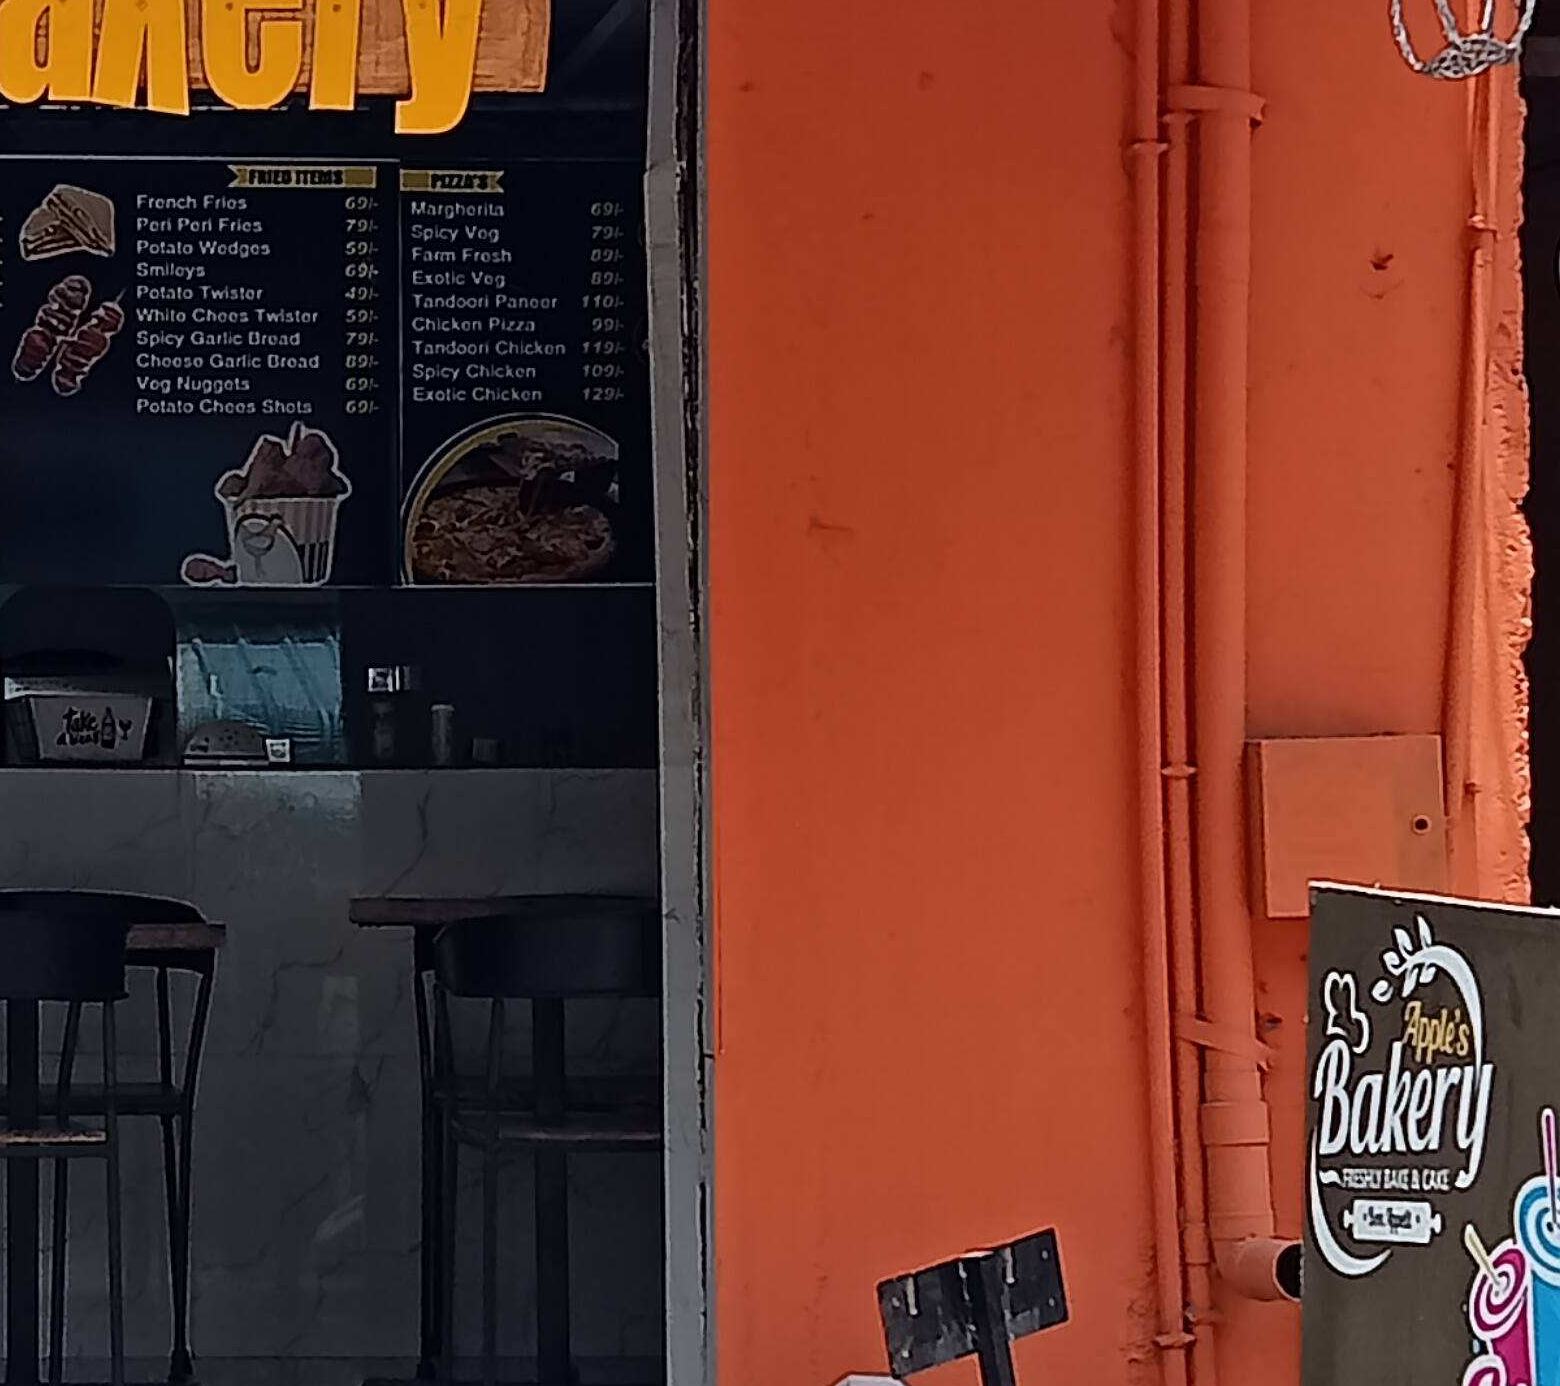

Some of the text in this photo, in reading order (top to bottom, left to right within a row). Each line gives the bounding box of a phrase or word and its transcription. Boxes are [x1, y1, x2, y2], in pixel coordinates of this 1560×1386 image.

[248, 170, 344, 185] FRIED ITEMS
[137, 195, 197, 209] French
[203, 195, 247, 209] Fries
[411, 201, 504, 219] Margherita
[137, 218, 171, 232] Peri
[177, 218, 212, 232] Peri
[219, 218, 263, 232] Fries
[411, 225, 459, 242] Spicy
[465, 225, 500, 243] Veg
[137, 240, 193, 255] Potato
[198, 241, 271, 258] Wedges
[411, 248, 455, 262] Farm
[462, 248, 512, 262] Fresh
[136, 263, 205, 280] Smileys
[412, 271, 465, 285] Exotic
[471, 271, 506, 288] Veg
[137, 286, 193, 300] Potato
[199, 286, 263, 300] Twister
[412, 294, 489, 309] Tandoori
[137, 309, 186, 323] White
[255, 309, 318, 323] Twister
[411, 317, 482, 332] Chicken
[489, 317, 536, 332] Pizza
[137, 331, 184, 348] Spicy
[190, 331, 243, 346] Garlic
[248, 331, 301, 346] Bread
[412, 341, 489, 355] Tandoori
[495, 341, 566, 355] Chicken
[210, 354, 261, 368] Garlic
[267, 354, 320, 368] Bread
[412, 364, 460, 381] Spicy
[466, 364, 536, 378] Chicken
[137, 377, 171, 393] Veg
[177, 377, 250, 394] Nuggets
[412, 387, 466, 402] Exotic
[472, 387, 542, 402] Chicken
[137, 399, 193, 414] Potato
[262, 399, 312, 414] Shots
[1404, 1001, 1470, 1064] Apple's
[1314, 1040, 1493, 1189] Bakery
